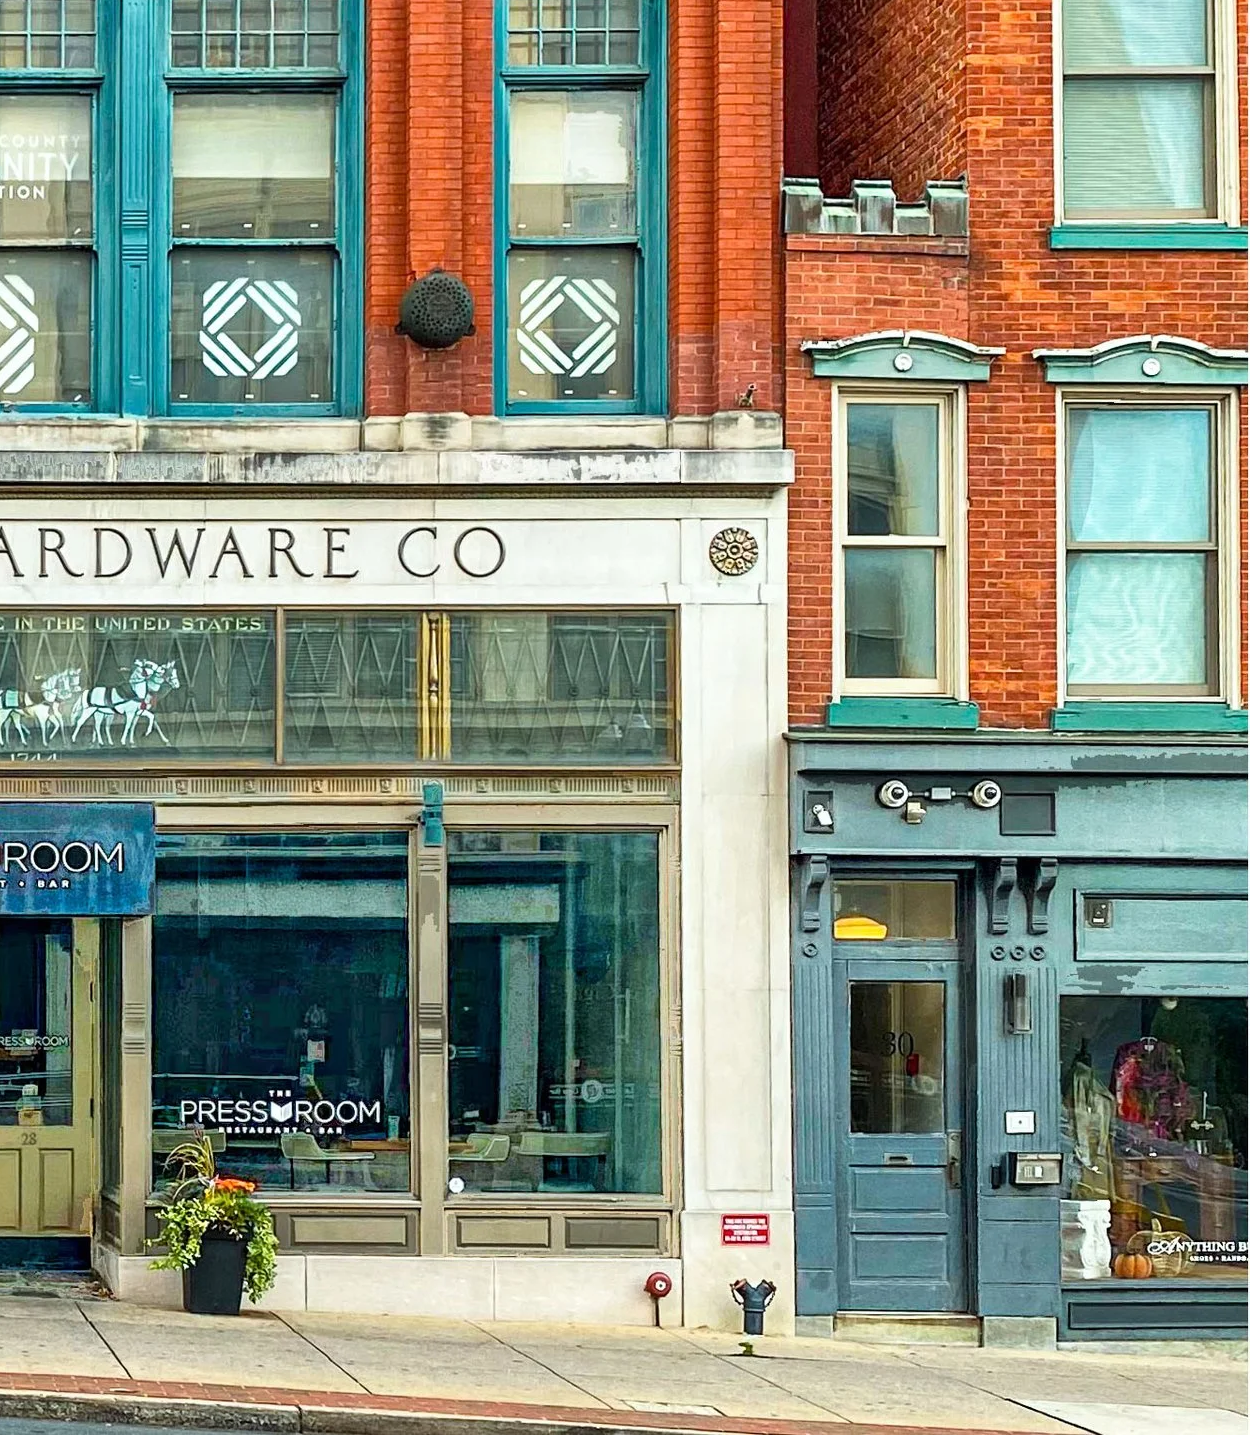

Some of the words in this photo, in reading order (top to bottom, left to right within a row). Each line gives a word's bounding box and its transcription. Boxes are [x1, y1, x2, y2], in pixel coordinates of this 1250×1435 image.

[397, 526, 506, 578] CO
[15, 616, 33, 631] IN
[43, 616, 85, 631] THE
[95, 616, 171, 631] UNITED
[181, 616, 264, 631] STATES
[3, 842, 124, 873] ROOM
[37, 878, 71, 889] BAR
[34, 1036, 68, 1047] ROOM
[881, 1031, 914, 1057] 30
[269, 1090, 292, 1098] THE
[181, 1100, 268, 1123] PRESS
[295, 1100, 381, 1124] ROOM
[21, 1133, 38, 1146] 28
[1147, 1236, 1236, 1256] ANYTHING
